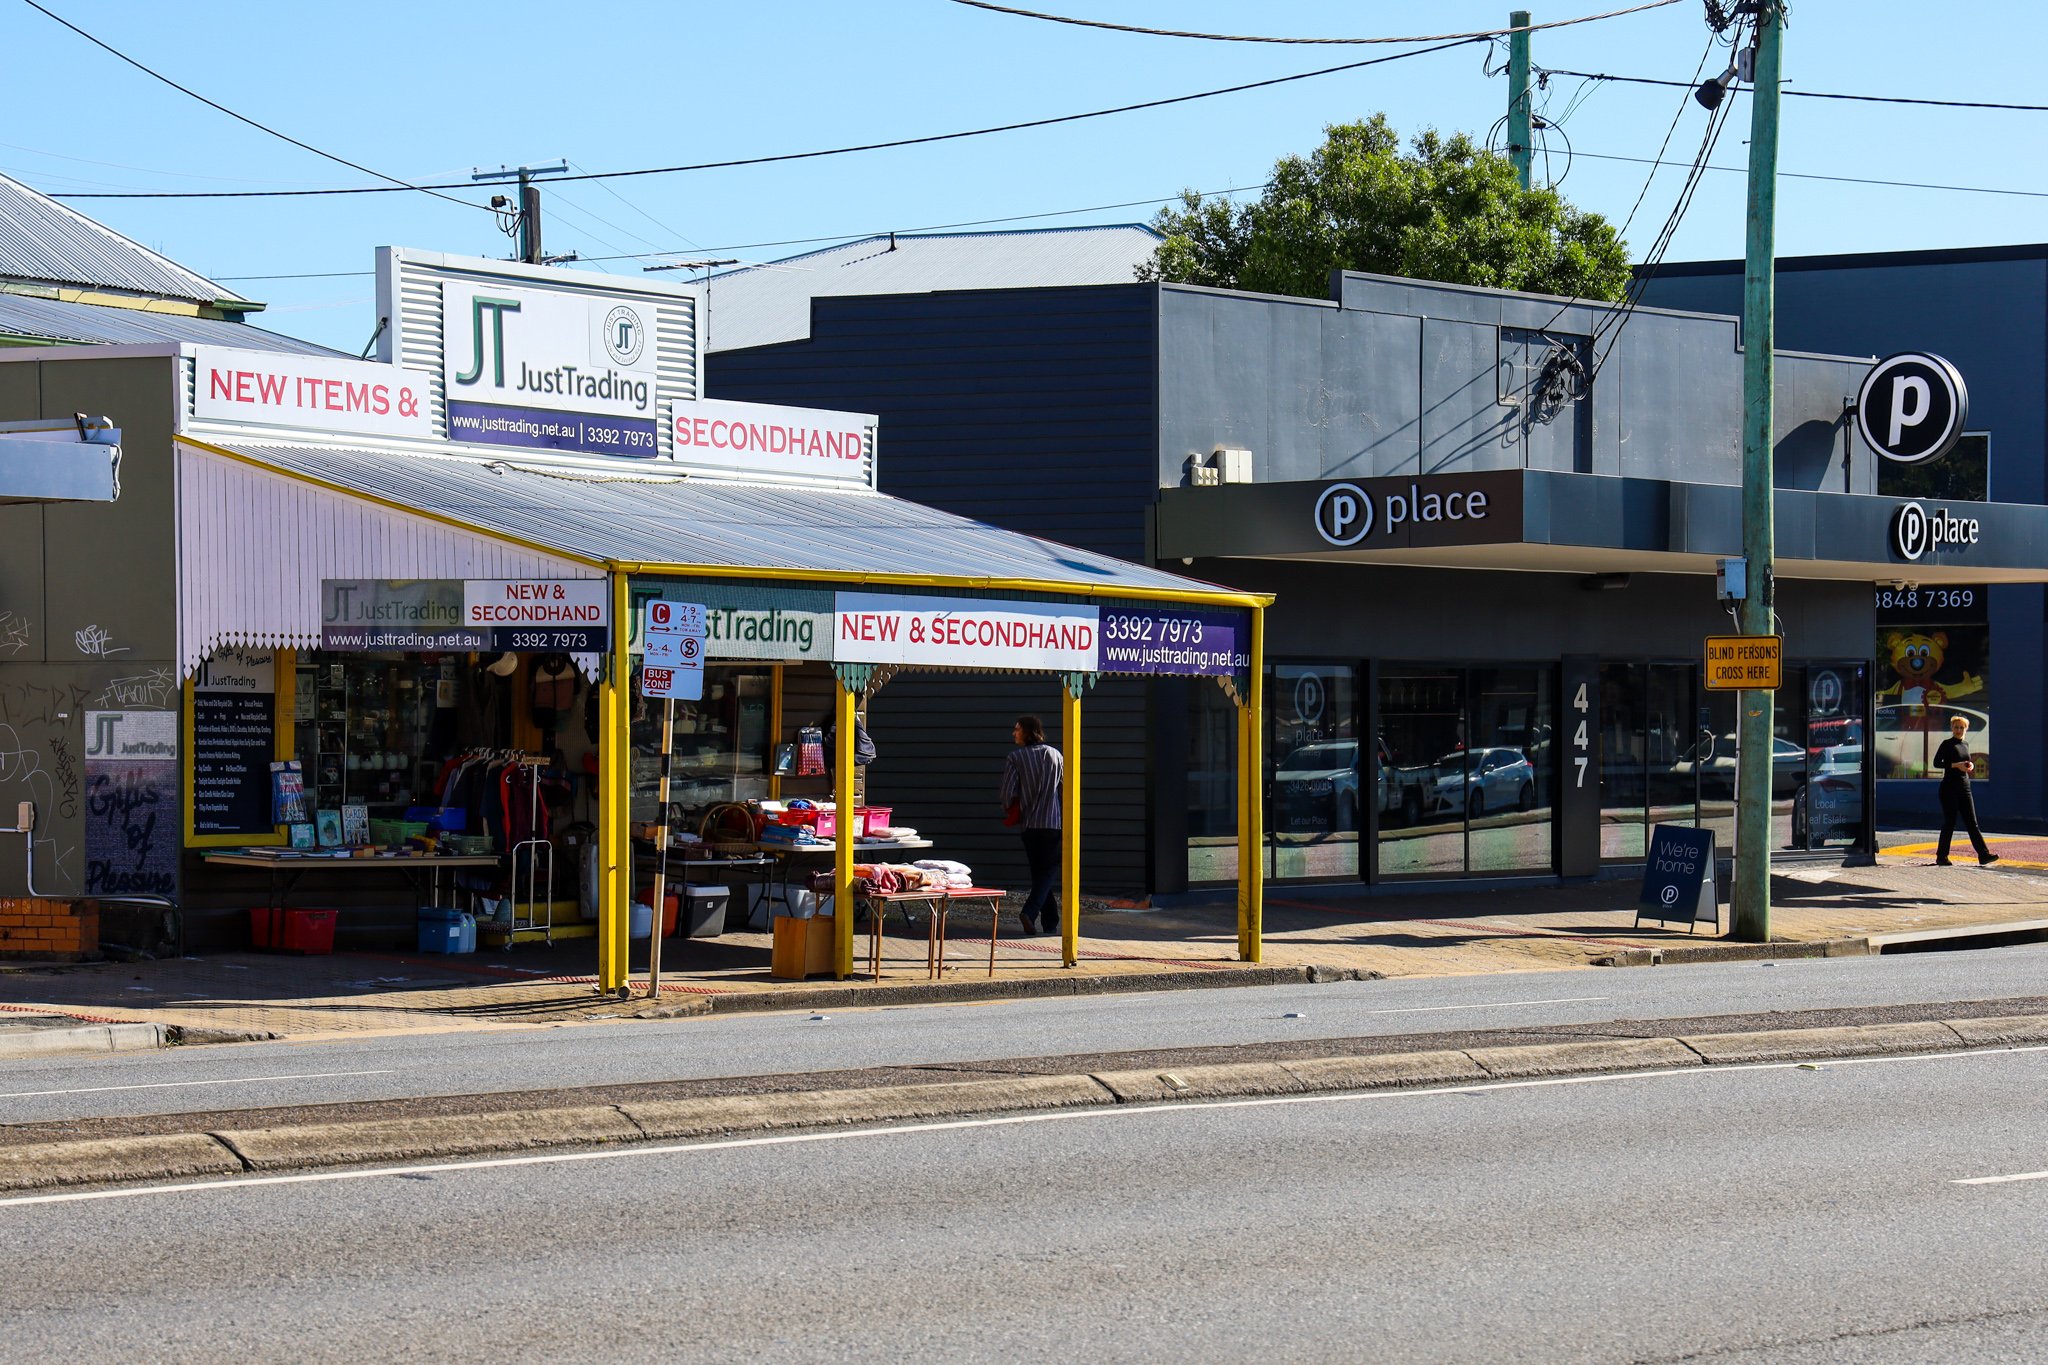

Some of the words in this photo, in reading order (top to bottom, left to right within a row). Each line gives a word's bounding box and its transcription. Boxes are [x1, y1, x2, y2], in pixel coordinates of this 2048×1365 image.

[210, 368, 288, 406] NEW
[296, 376, 390, 416] ITEMS
[397, 386, 419, 418] &
[516, 361, 648, 411] JustTrading
[452, 415, 575, 438] www.justtrading.net.au
[587, 427, 620, 444] 3392
[623, 430, 654, 447] 7973
[675, 416, 862, 460] SECONDHAND
[1386, 484, 1487, 534] place
[1931, 508, 1980, 552] place
[506, 584, 548, 600] NEW
[552, 585, 566, 600] &
[1925, 590, 1974, 607] 7369
[356, 600, 460, 624] JustTrading
[471, 605, 600, 621] SECONDHAND
[841, 614, 900, 641] NEW
[908, 617, 926, 643] &
[930, 617, 1093, 650] SECONDHAND
[1106, 614, 1152, 641] 3392
[1158, 617, 1203, 645] 7973
[328, 633, 481, 650] www.justtrading.net.au
[512, 633, 548, 648] 3392
[552, 633, 588, 648] 7973
[1106, 644, 1250, 670] www.justtrading.net.au
[1708, 645, 1735, 661] BLIND
[1737, 646, 1778, 660] PERSONS
[211, 675, 256, 689] JustTrading
[647, 669, 669, 680] BUS
[1715, 666, 1744, 680] CROSS
[1747, 666, 1771, 680] HERE
[644, 679, 671, 690] ZONE
[1295, 726, 1324, 747] place
[1809, 814, 1821, 825] eal
[1823, 813, 1847, 824] Estate
[1809, 828, 1846, 841] pecialists
[1660, 840, 1698, 859] We're
[1656, 857, 1695, 875] home
